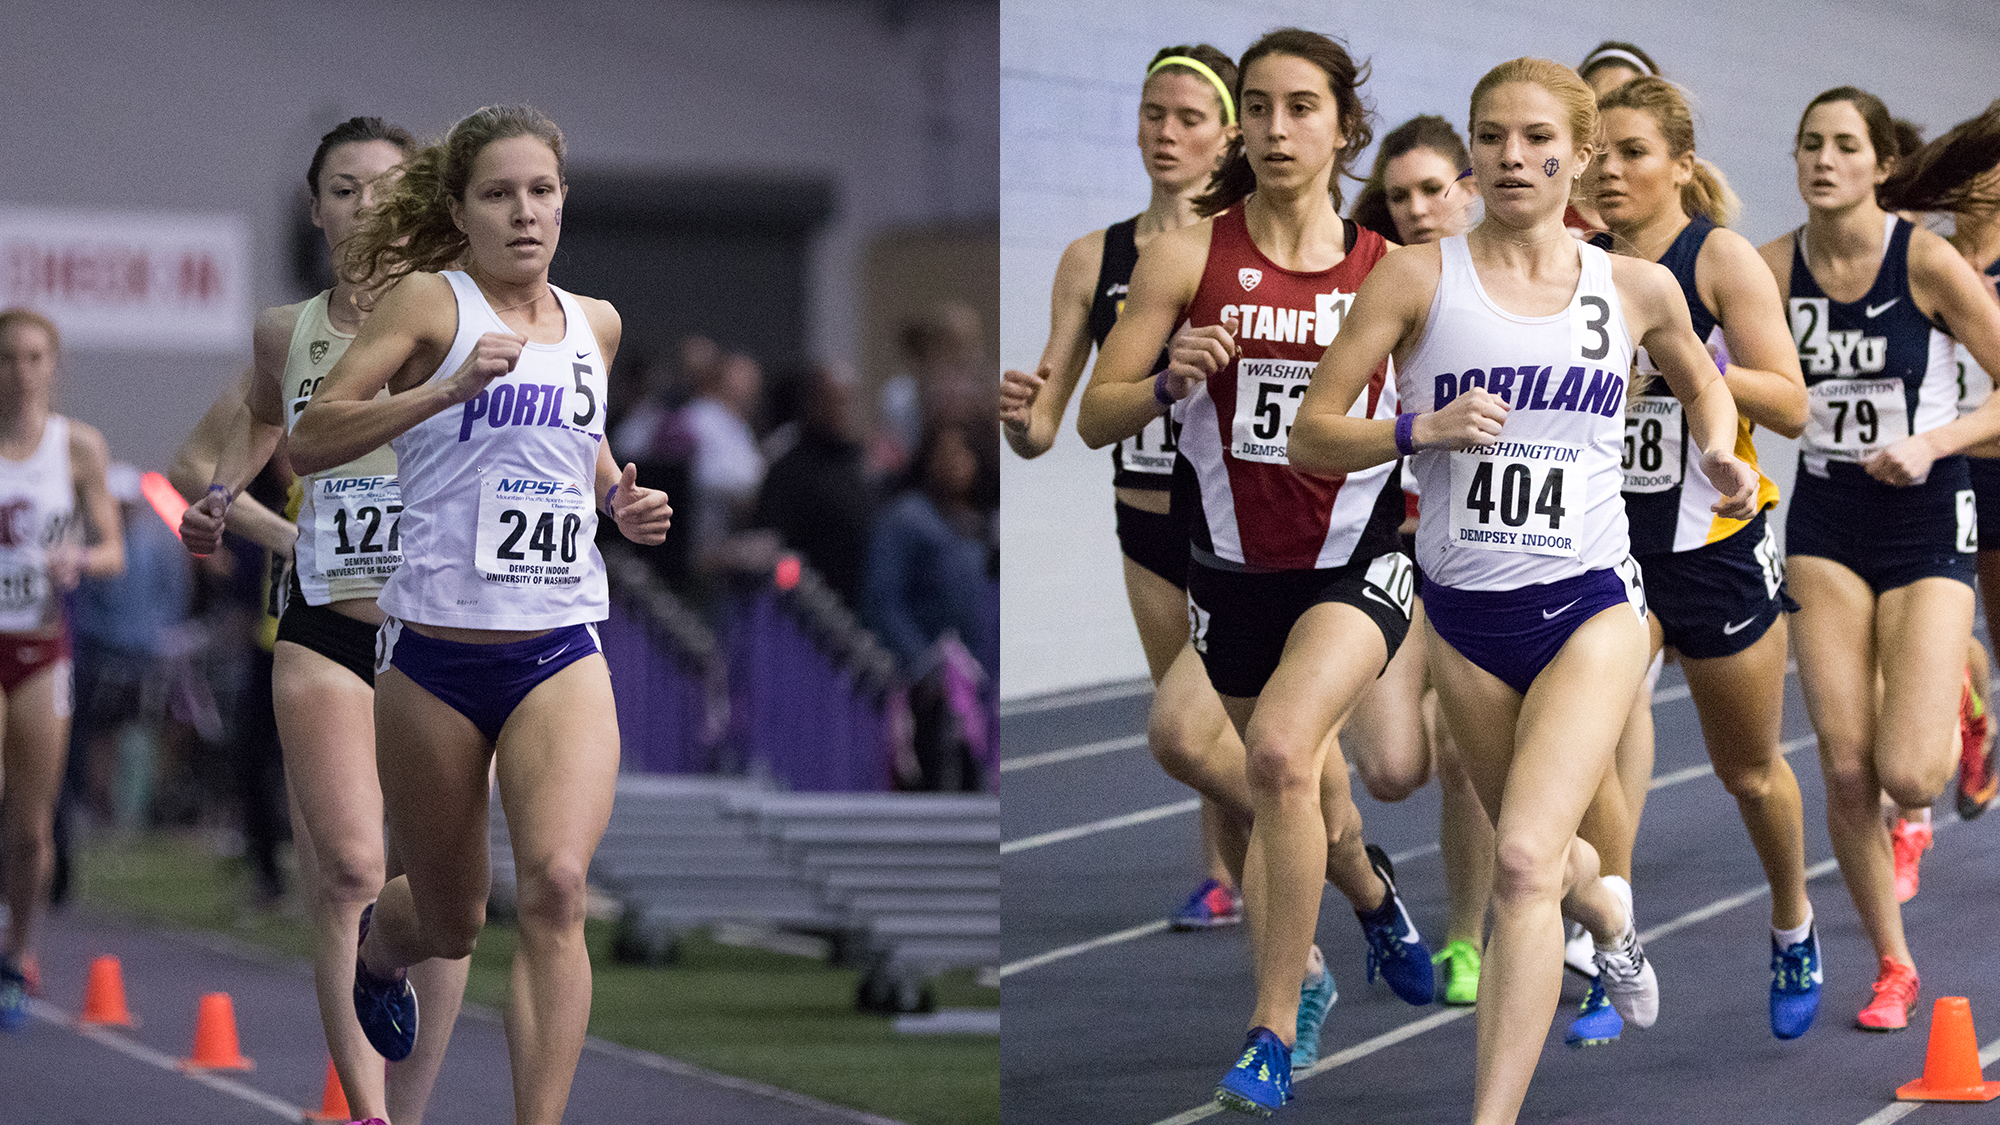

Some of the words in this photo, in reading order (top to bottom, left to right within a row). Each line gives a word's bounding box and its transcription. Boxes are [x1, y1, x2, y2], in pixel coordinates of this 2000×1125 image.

[1220, 304, 1316, 344] STANF
[1580, 295, 1610, 360] 3
[1798, 303, 1818, 355] 2
[1248, 363, 1315, 379] WASHIN
[572, 362, 596, 426] 5
[1434, 365, 1625, 418] PORTLAND
[458, 383, 606, 443] PORTL
[1828, 400, 1878, 444] 79
[1243, 443, 1287, 457] DEMPS
[1460, 442, 1580, 462] WASHINGTON
[1621, 418, 1662, 472] 58
[323, 477, 385, 493] MPSF
[497, 478, 564, 495] MPSF
[1466, 461, 1566, 529] 404
[1629, 475, 1672, 486] INDOOR
[334, 505, 404, 555] 127
[497, 509, 581, 563] 240
[1460, 528, 1518, 544] DEMPSEY
[1521, 533, 1573, 549] INDOOR
[326, 567, 366, 577] UNIVERSITY
[367, 566, 375, 575] OF
[345, 557, 373, 566] DEMPSEY
[376, 555, 402, 564] INDOOR
[486, 573, 531, 584] UNIVERSITY
[533, 576, 543, 584] OF
[544, 576, 581, 585] WASHINGTON
[509, 564, 544, 574] DEMPSEY
[545, 566, 570, 575] INDOOR
[1385, 553, 1413, 606] 10
